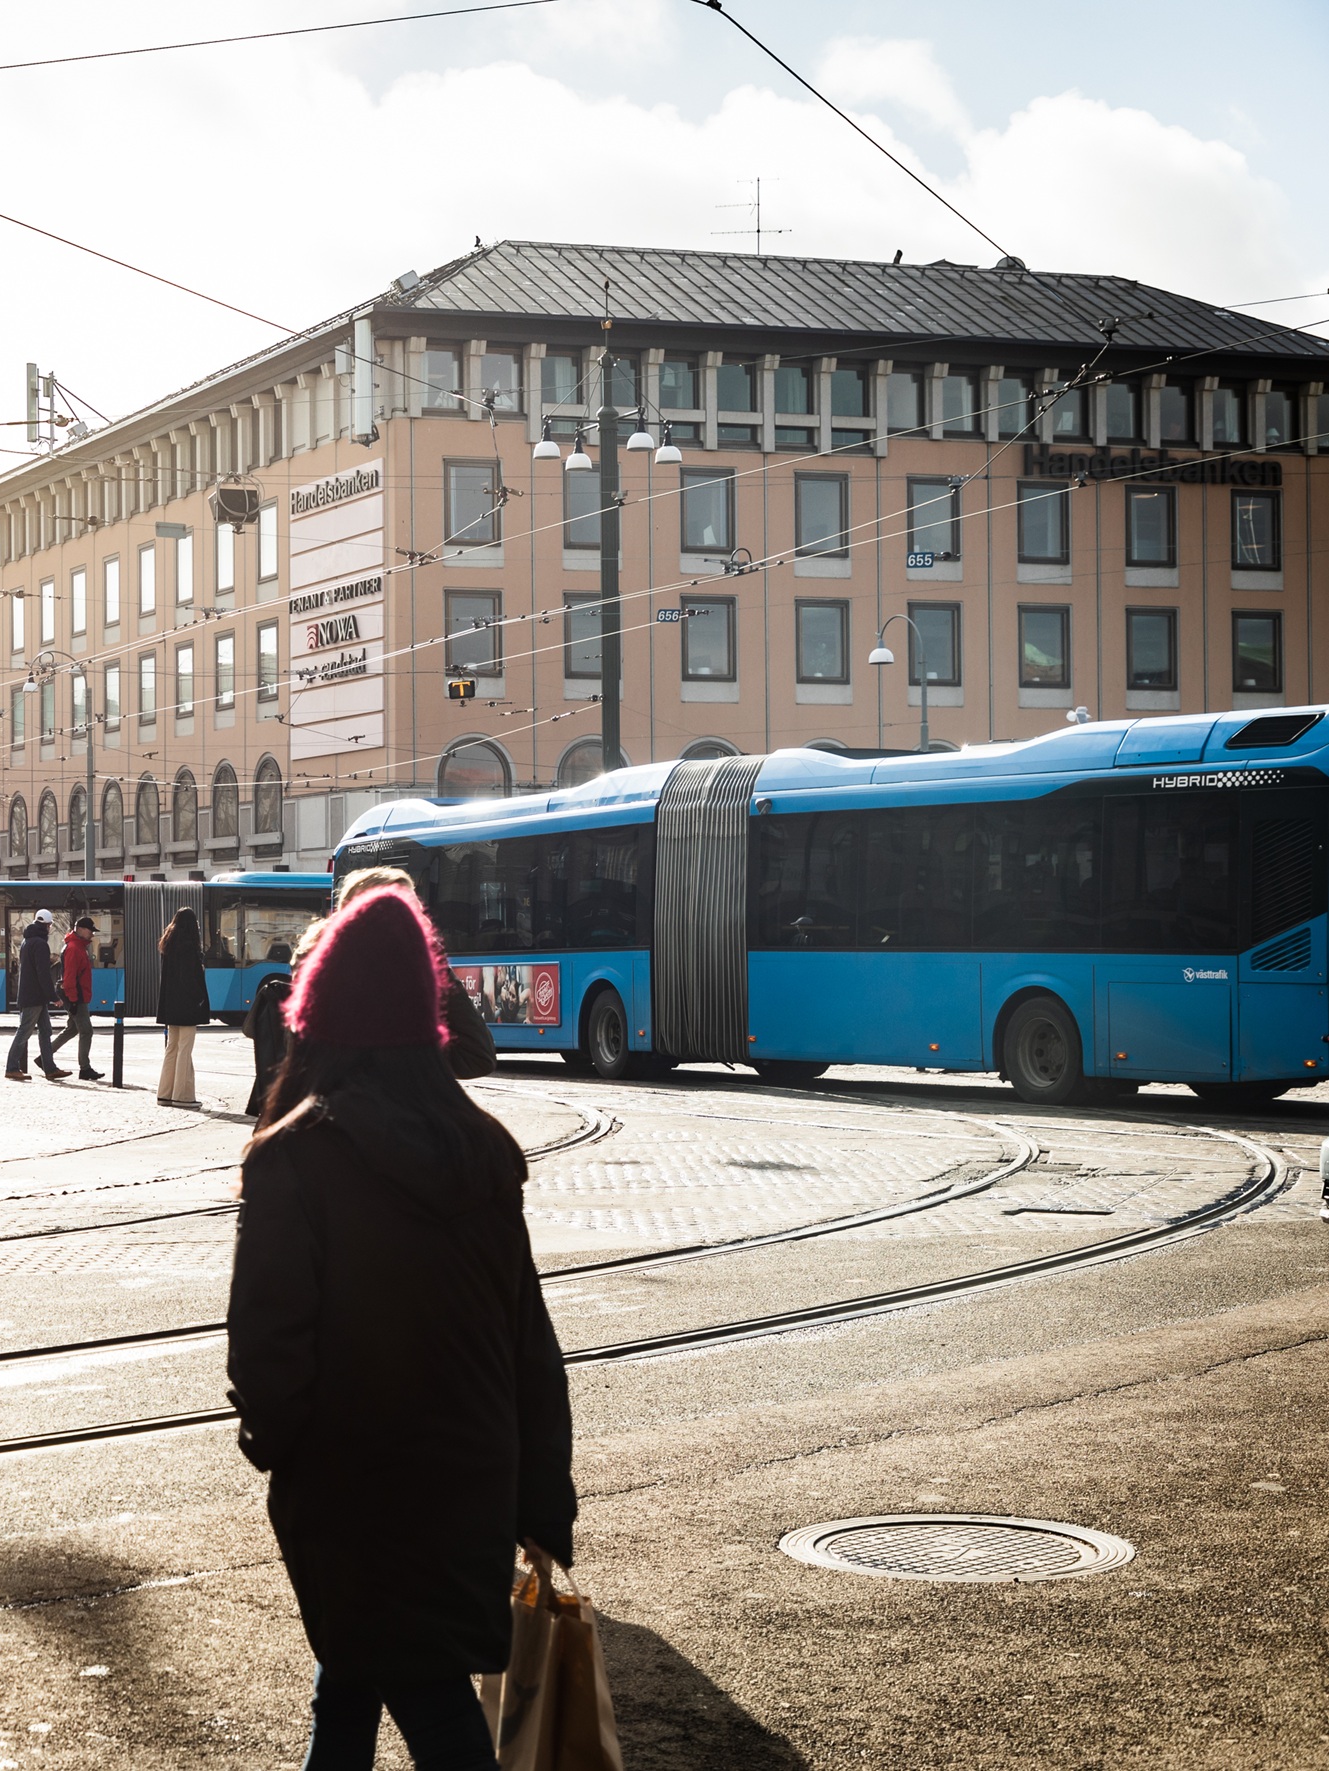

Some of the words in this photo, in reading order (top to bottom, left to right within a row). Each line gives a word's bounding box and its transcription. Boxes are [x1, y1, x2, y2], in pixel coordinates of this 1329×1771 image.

[1024, 443, 1283, 486] Handelsbanken
[291, 469, 379, 515] Handelsbanken
[908, 554, 932, 566] 655
[289, 591, 325, 615] TENANT
[333, 576, 382, 603] PARTNER
[658, 610, 679, 621] 656
[452, 681, 471, 697] T
[1152, 775, 1218, 788] HYBRID
[1195, 969, 1228, 980] västtrafik
[466, 975, 476, 990] för
